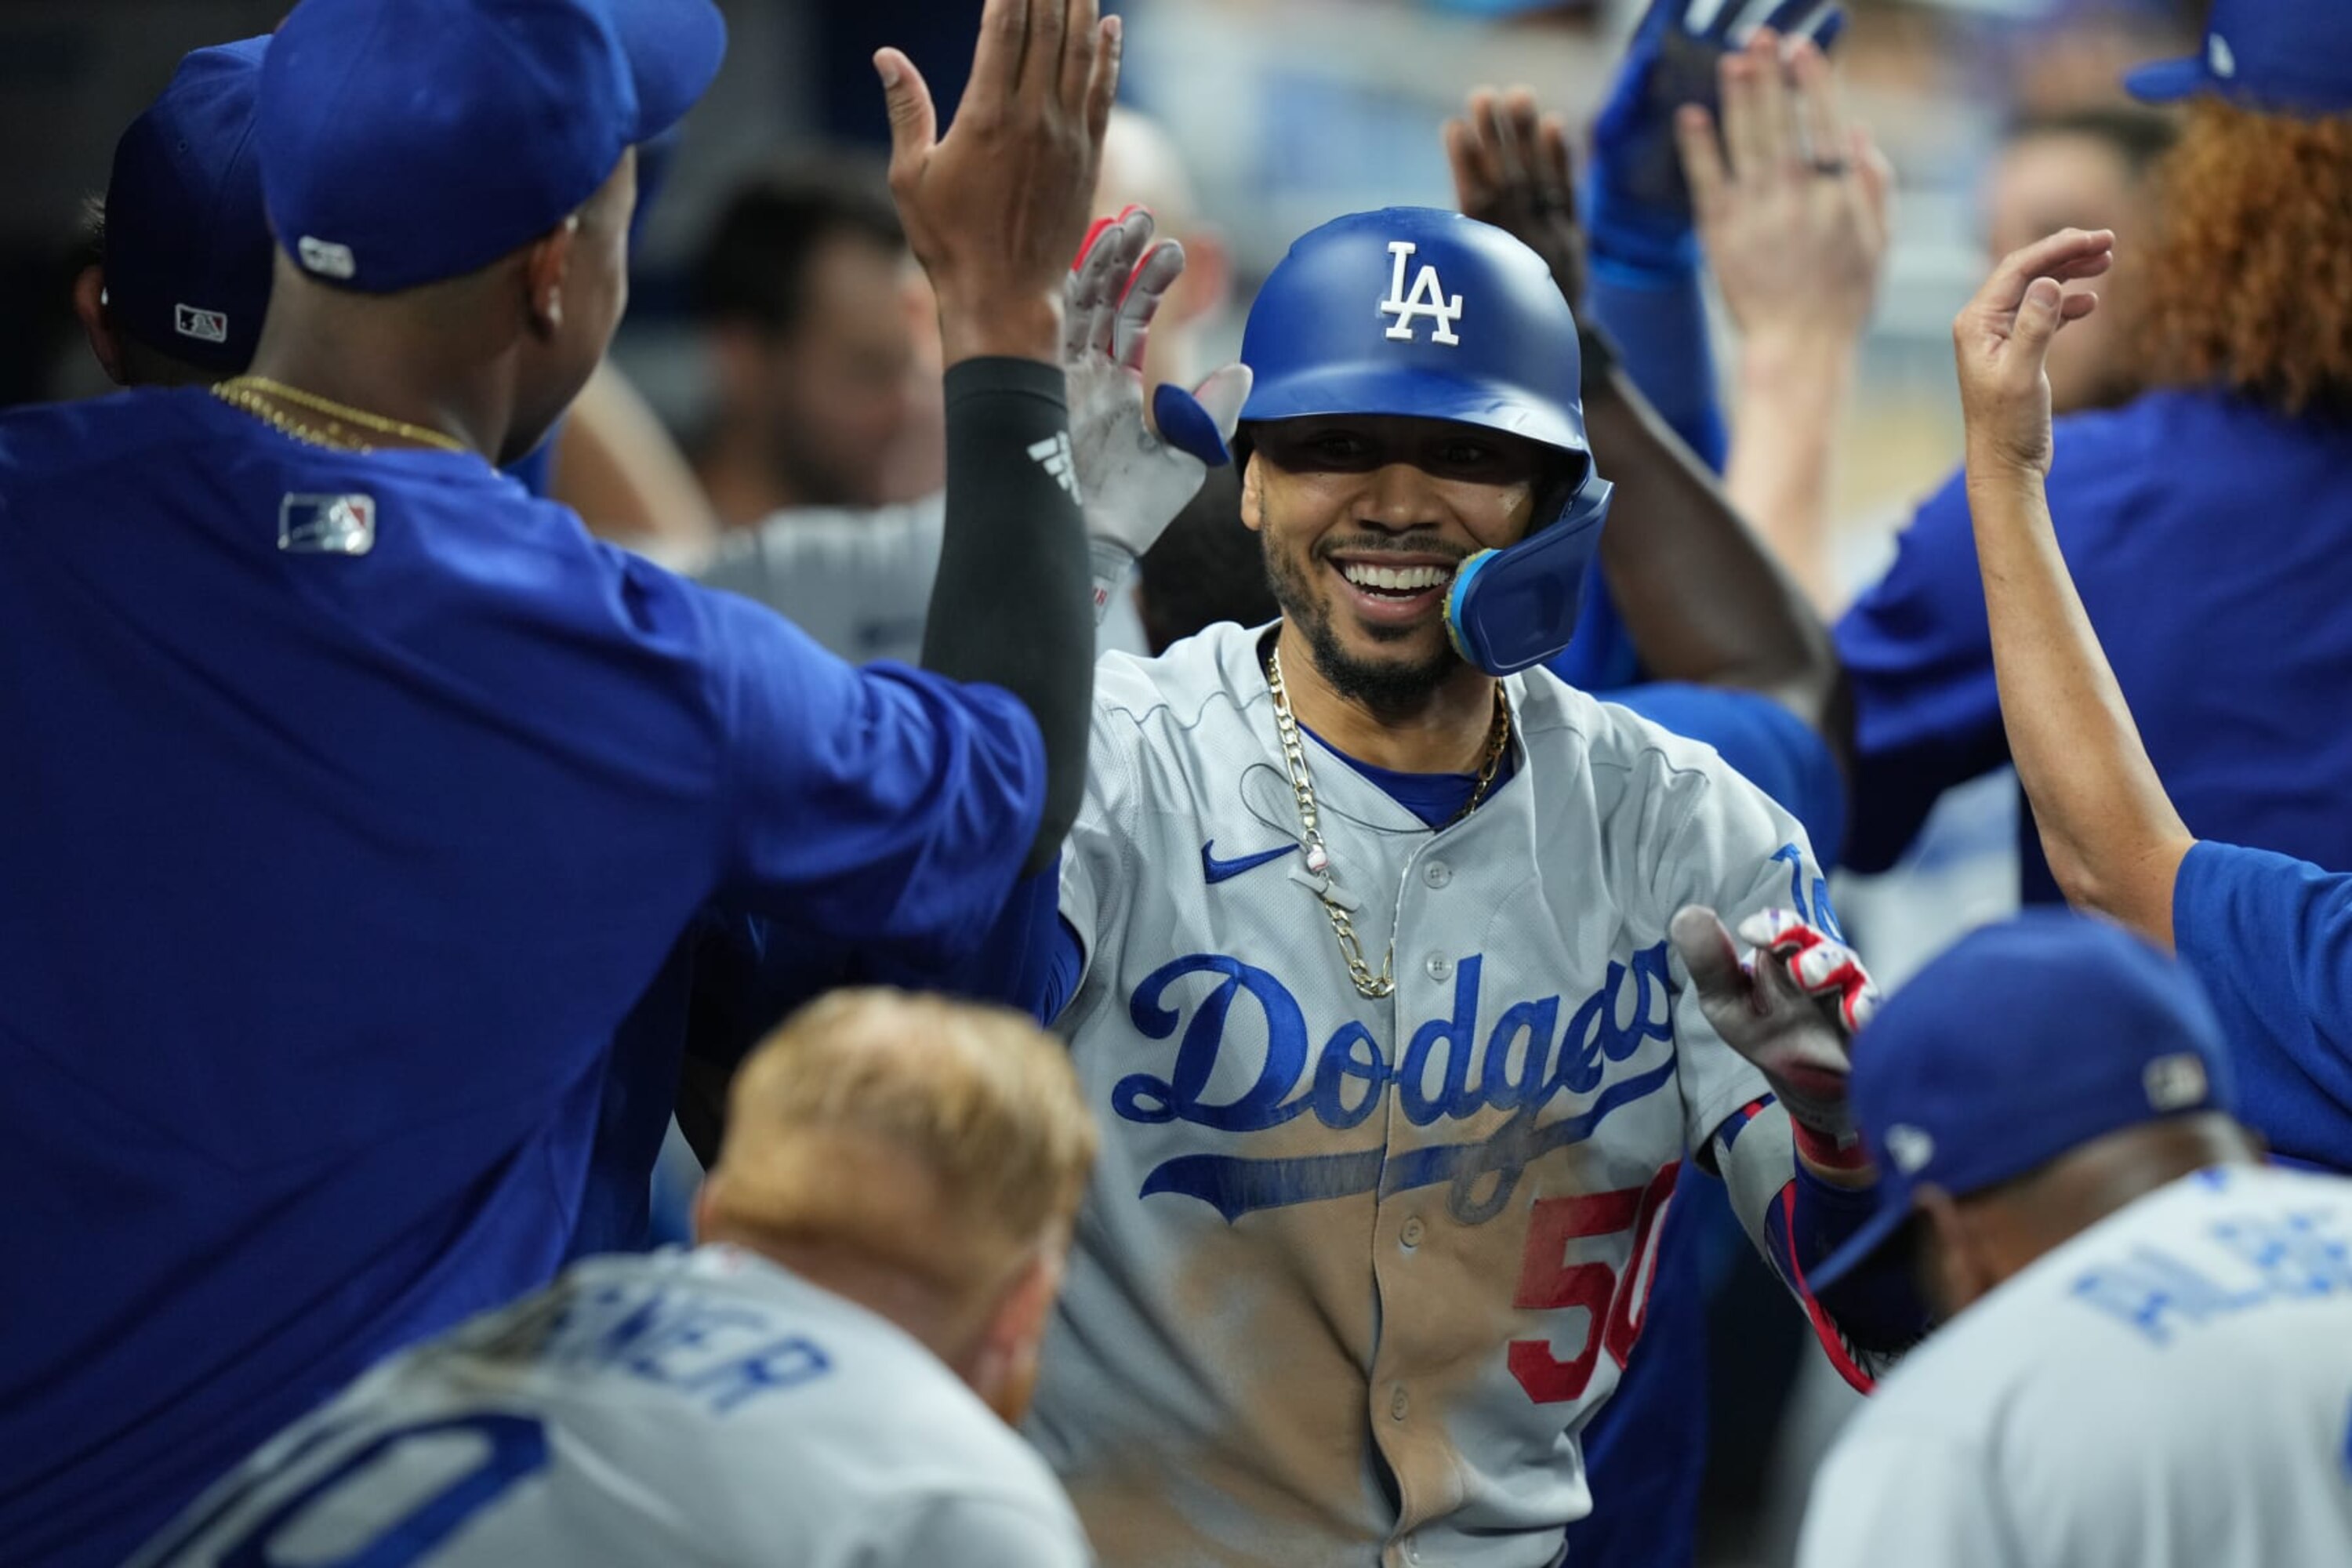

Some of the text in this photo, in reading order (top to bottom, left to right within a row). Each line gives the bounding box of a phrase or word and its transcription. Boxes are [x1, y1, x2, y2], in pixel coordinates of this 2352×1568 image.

[1381, 241, 1463, 346] LA
[1111, 939, 1674, 1225] Dodgers
[1508, 1159, 1682, 1404] 50
